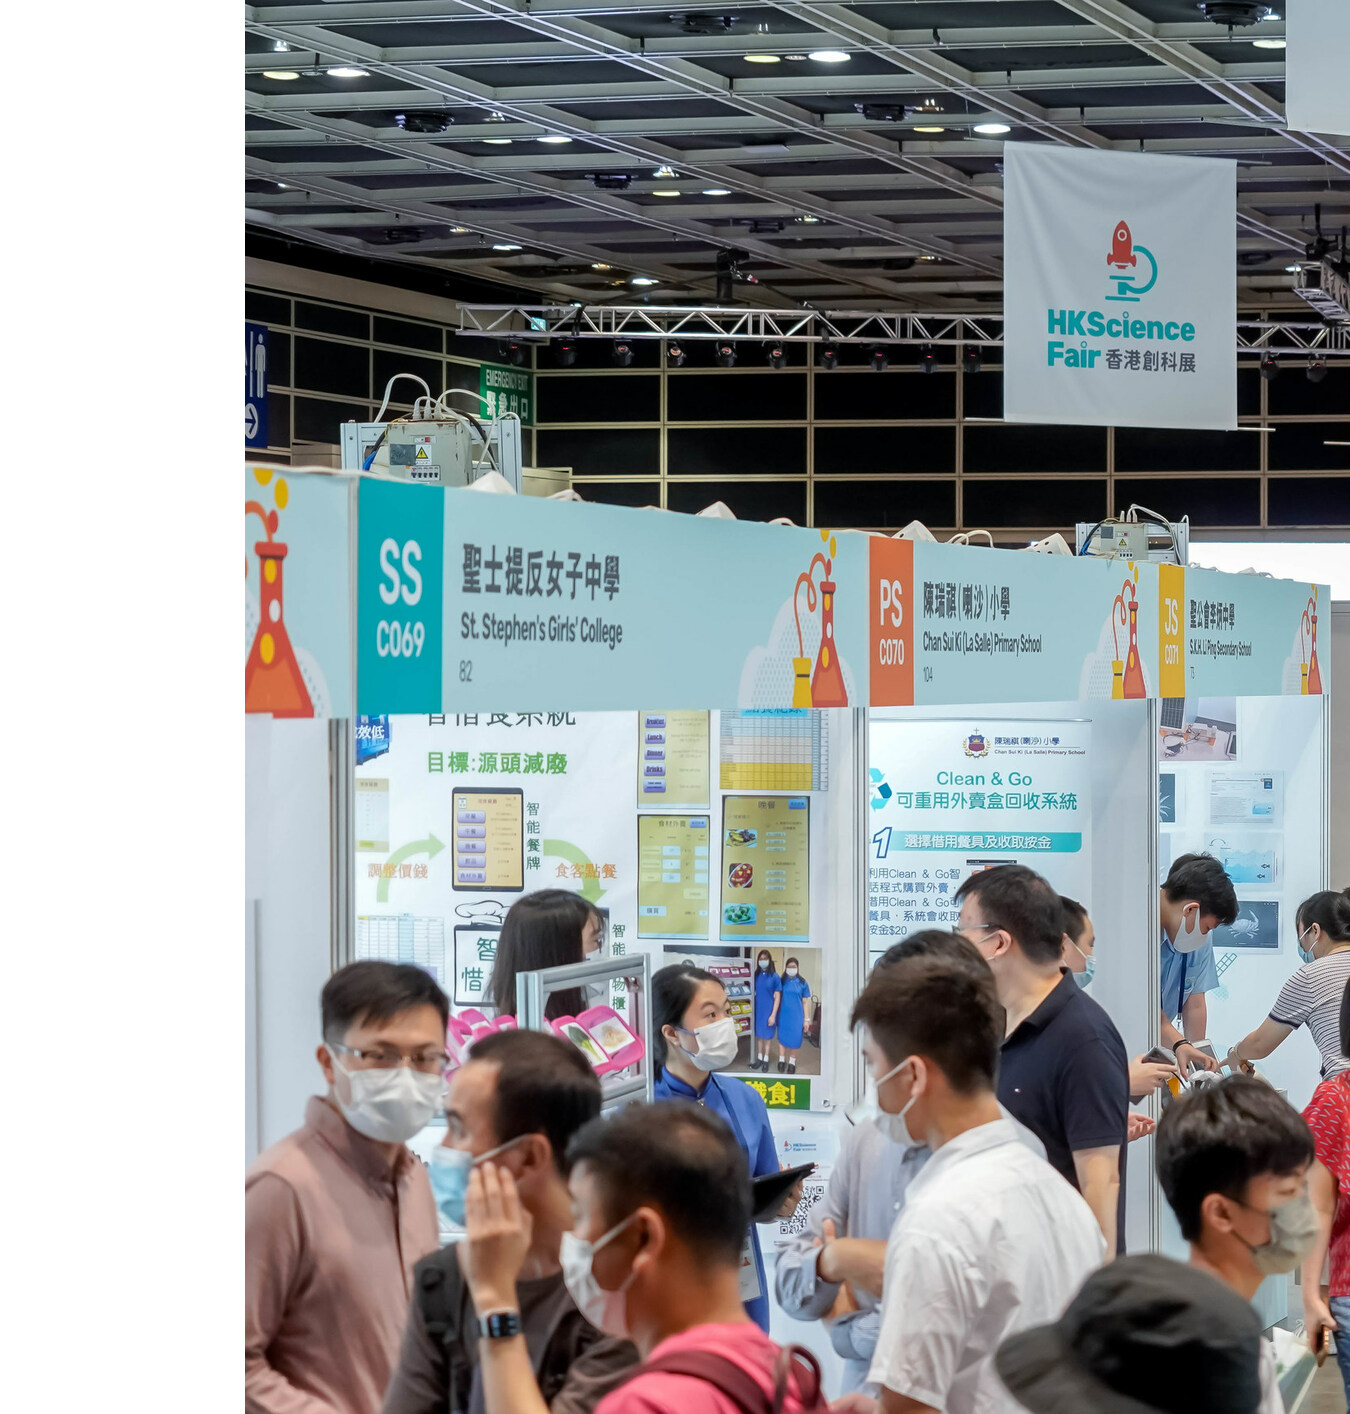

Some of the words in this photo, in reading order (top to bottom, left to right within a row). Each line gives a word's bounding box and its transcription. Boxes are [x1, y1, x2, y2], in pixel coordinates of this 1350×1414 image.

[1047, 308, 1196, 342] HKScience
[1047, 341, 1101, 369] Fair
[1105, 349, 1196, 373] 香港創科展
[485, 369, 517, 390] EMERGENCY
[518, 374, 528, 391] EXIT
[378, 537, 423, 606] SS
[461, 543, 620, 601] 聖士提反女子中學
[880, 578, 903, 628] PS
[1164, 597, 1179, 636] JS
[376, 620, 425, 658] C069
[461, 611, 479, 640] St.
[482, 612, 546, 648] Stephen's
[548, 614, 578, 643] Girls'
[580, 616, 623, 651] College
[923, 631, 942, 652] Chan
[943, 631, 954, 652] Sui
[955, 631, 962, 652] Ki
[962, 630, 973, 656] (La
[974, 631, 993, 656] Salle)
[994, 632, 1020, 657] Primary
[1021, 633, 1042, 653] School
[879, 638, 904, 665] C070
[1239, 641, 1252, 657] School
[459, 660, 473, 682] 82
[923, 666, 933, 683] 104
[355, 724, 385, 740] 效低
[936, 771, 985, 786] Clean
[991, 771, 1004, 786] &
[1008, 771, 1033, 786] Go
[896, 791, 1078, 811] 可重用外賣盒回收系統
[526, 802, 541, 871] 智能餐牌
[872, 826, 893, 859] 1
[904, 833, 1053, 850] 選擇借用餐具及收取按金
[367, 863, 429, 880] 調整價錢
[555, 862, 618, 880] 食客點餐
[922, 868, 930, 879] &
[935, 868, 960, 880] Go智
[922, 897, 930, 908] &
[461, 966, 484, 993] 惜
[611, 923, 627, 1011] 智能物櫃
